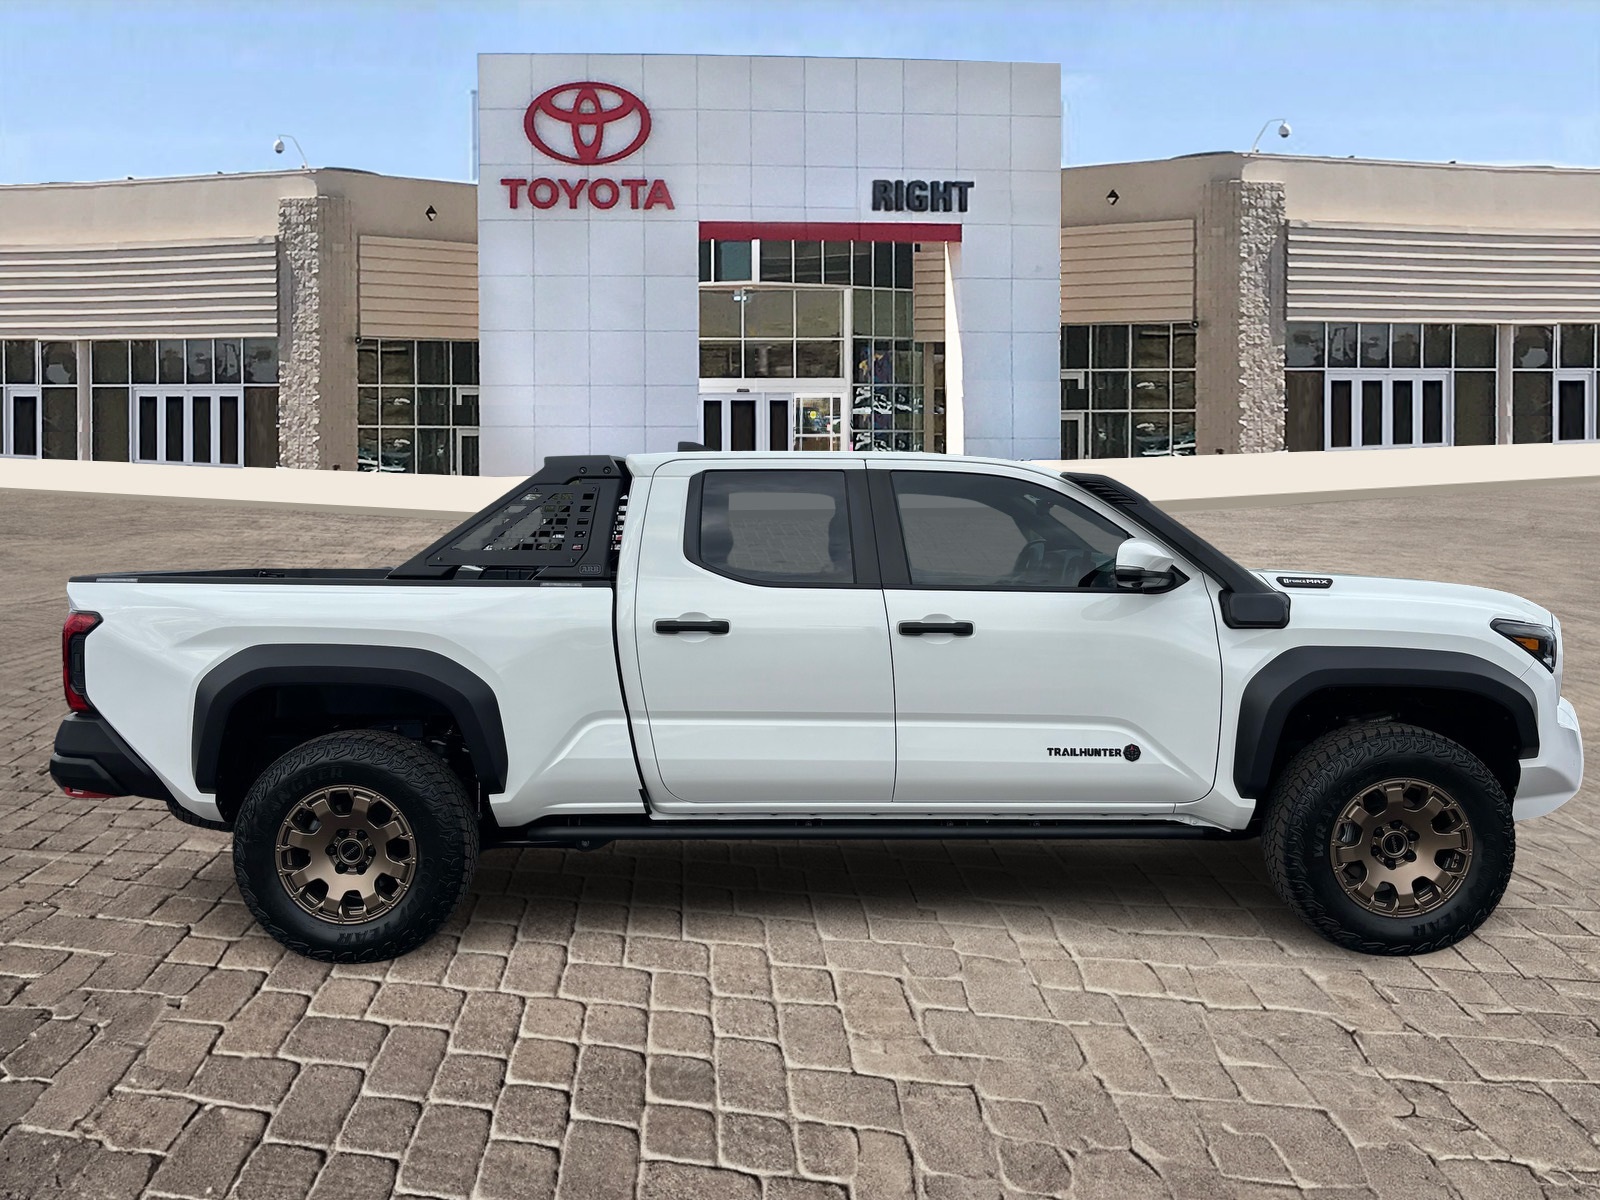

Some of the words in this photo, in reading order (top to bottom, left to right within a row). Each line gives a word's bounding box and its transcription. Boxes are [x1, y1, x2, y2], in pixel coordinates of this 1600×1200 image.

[500, 177, 675, 211] TOYOTA
[871, 179, 974, 214] RIGHT
[1047, 747, 1122, 757] TRAILHUNTER
